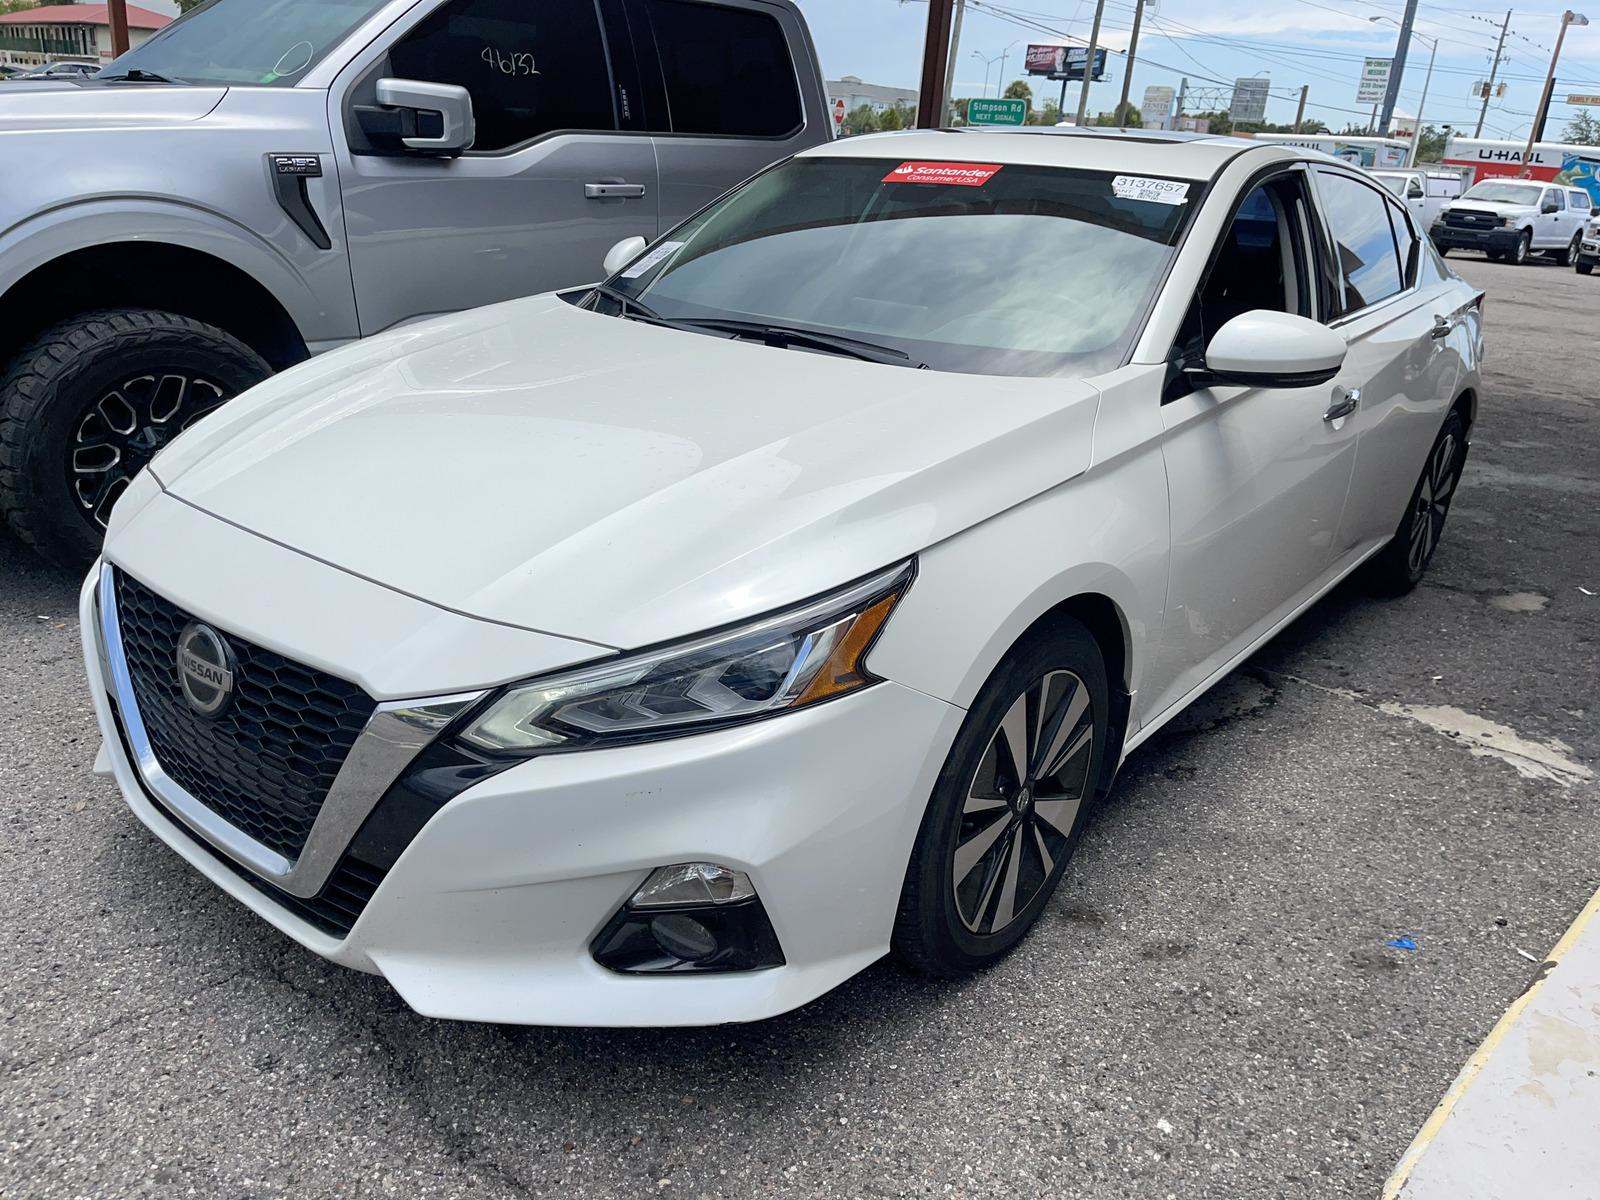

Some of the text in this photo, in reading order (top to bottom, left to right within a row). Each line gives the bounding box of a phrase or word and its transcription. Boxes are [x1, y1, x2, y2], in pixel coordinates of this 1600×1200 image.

[973, 102, 1022, 113] Simpson Rd
[975, 113, 991, 121] NEXT
[1478, 149, 1544, 164] U-HAUL
[913, 166, 994, 178] Santander
[906, 174, 979, 184] Consumer USA
[1117, 177, 1185, 193] 3137657
[181, 654, 223, 686] NISSAN
